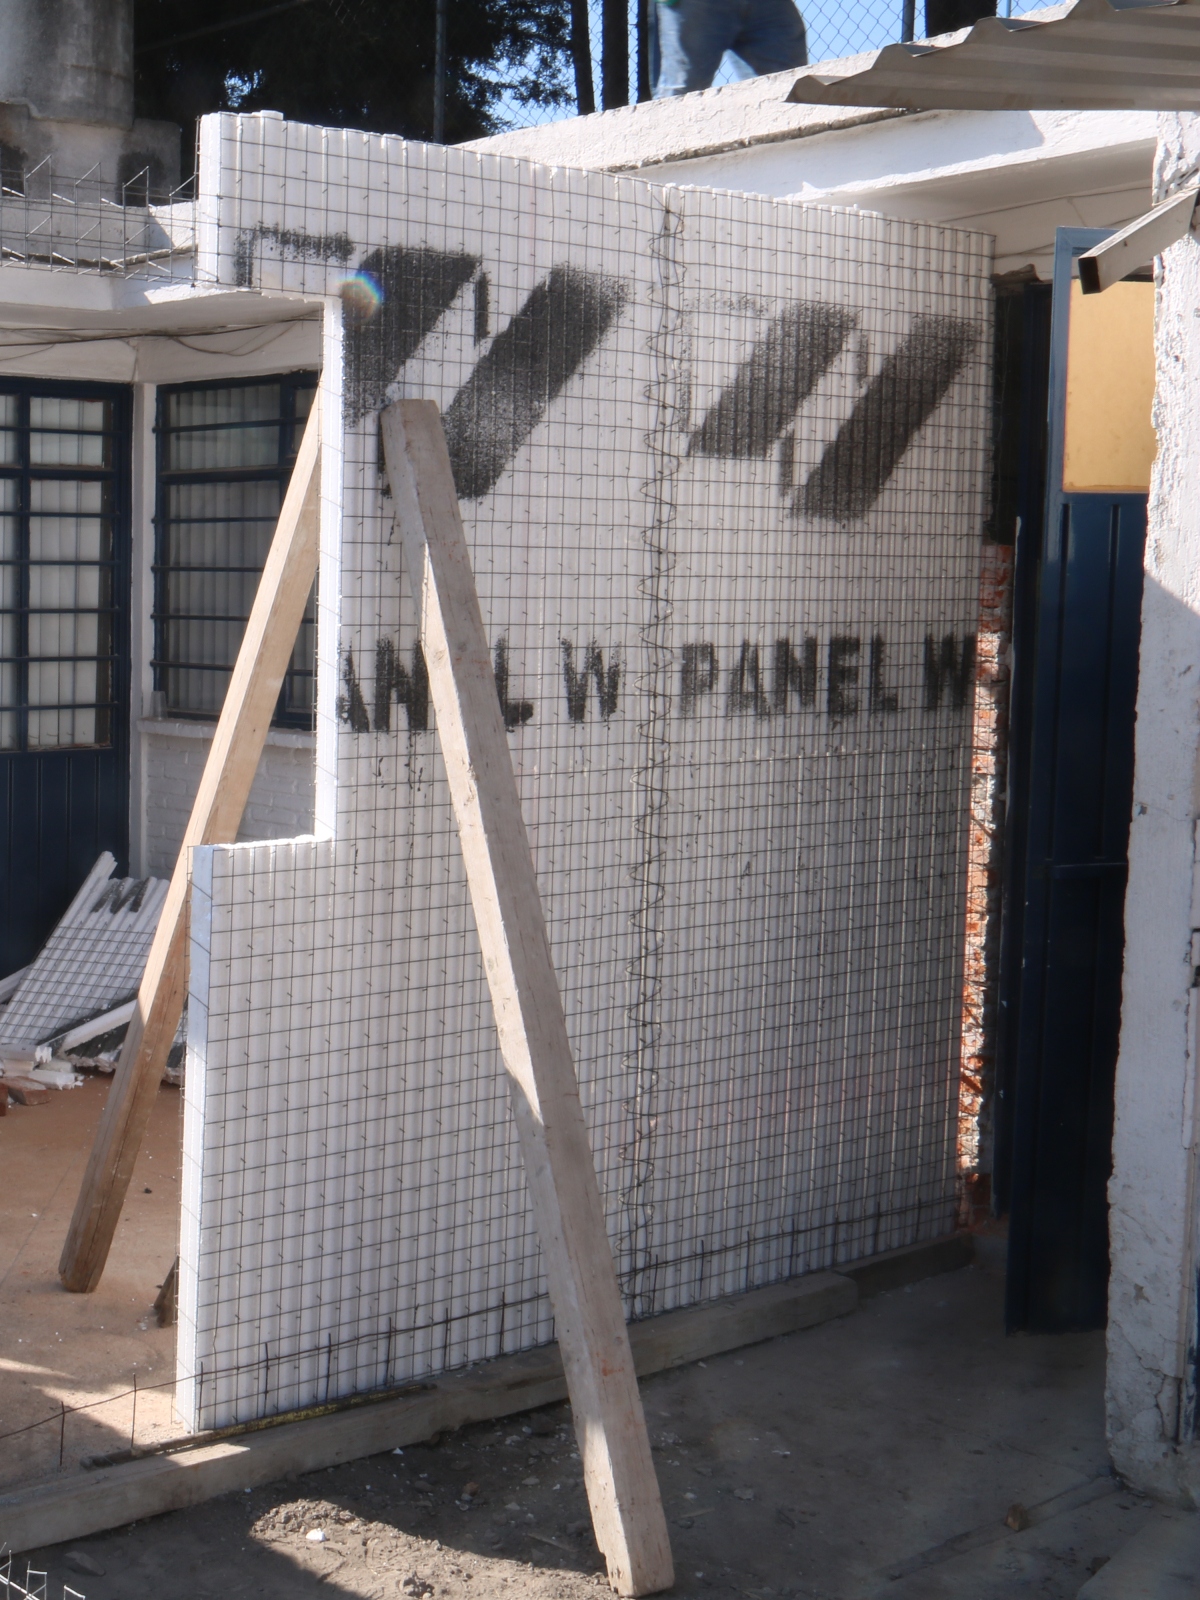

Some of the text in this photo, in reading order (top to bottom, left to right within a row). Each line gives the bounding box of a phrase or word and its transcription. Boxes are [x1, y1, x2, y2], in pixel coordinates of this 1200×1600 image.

[560, 634, 622, 721] W
[680, 632, 977, 720] PANEL W
